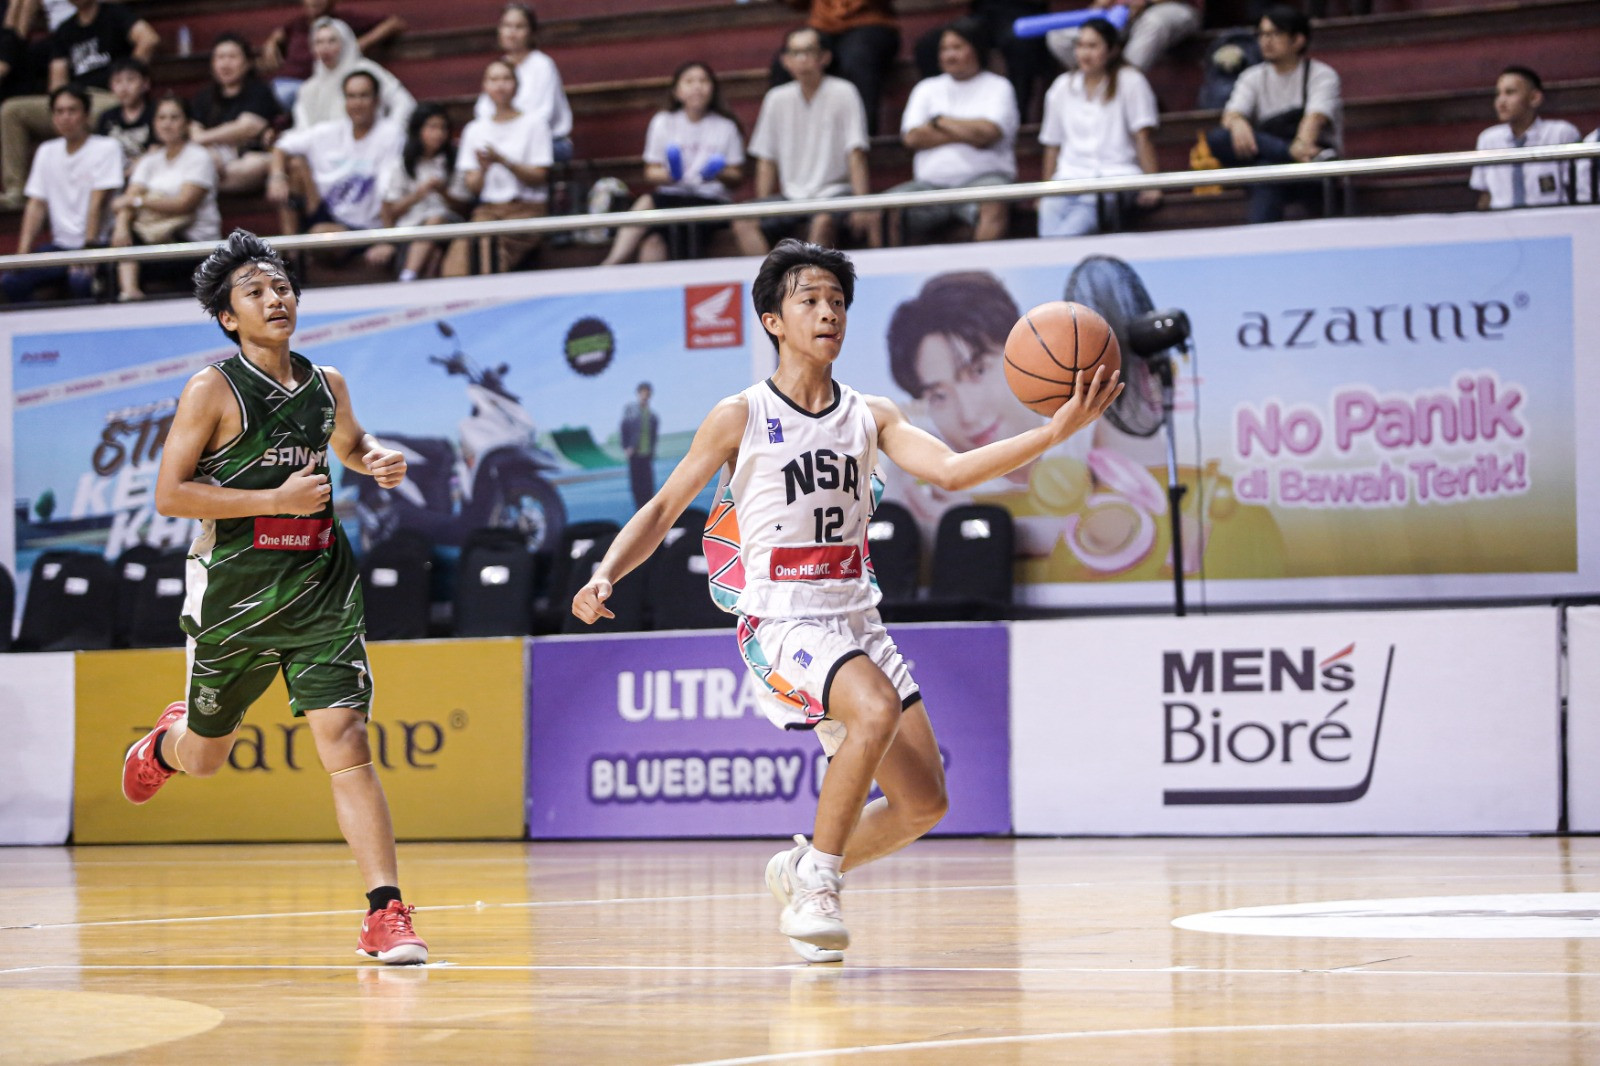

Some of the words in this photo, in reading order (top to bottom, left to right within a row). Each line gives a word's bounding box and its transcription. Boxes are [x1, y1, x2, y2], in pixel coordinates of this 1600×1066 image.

[1237, 403, 1322, 457] No
[1334, 376, 1523, 452] Panik
[781, 449, 860, 505] NSA
[1237, 468, 1268, 499] di
[1279, 462, 1406, 502] Bawah
[1409, 453, 1527, 498] Terik!
[259, 533, 280, 545] One
[814, 506, 844, 543] 12
[775, 564, 797, 577] One
[617, 668, 766, 722] ULTRA
[1162, 698, 1353, 764] Bioré
[591, 754, 799, 801] BLUEBERRY
